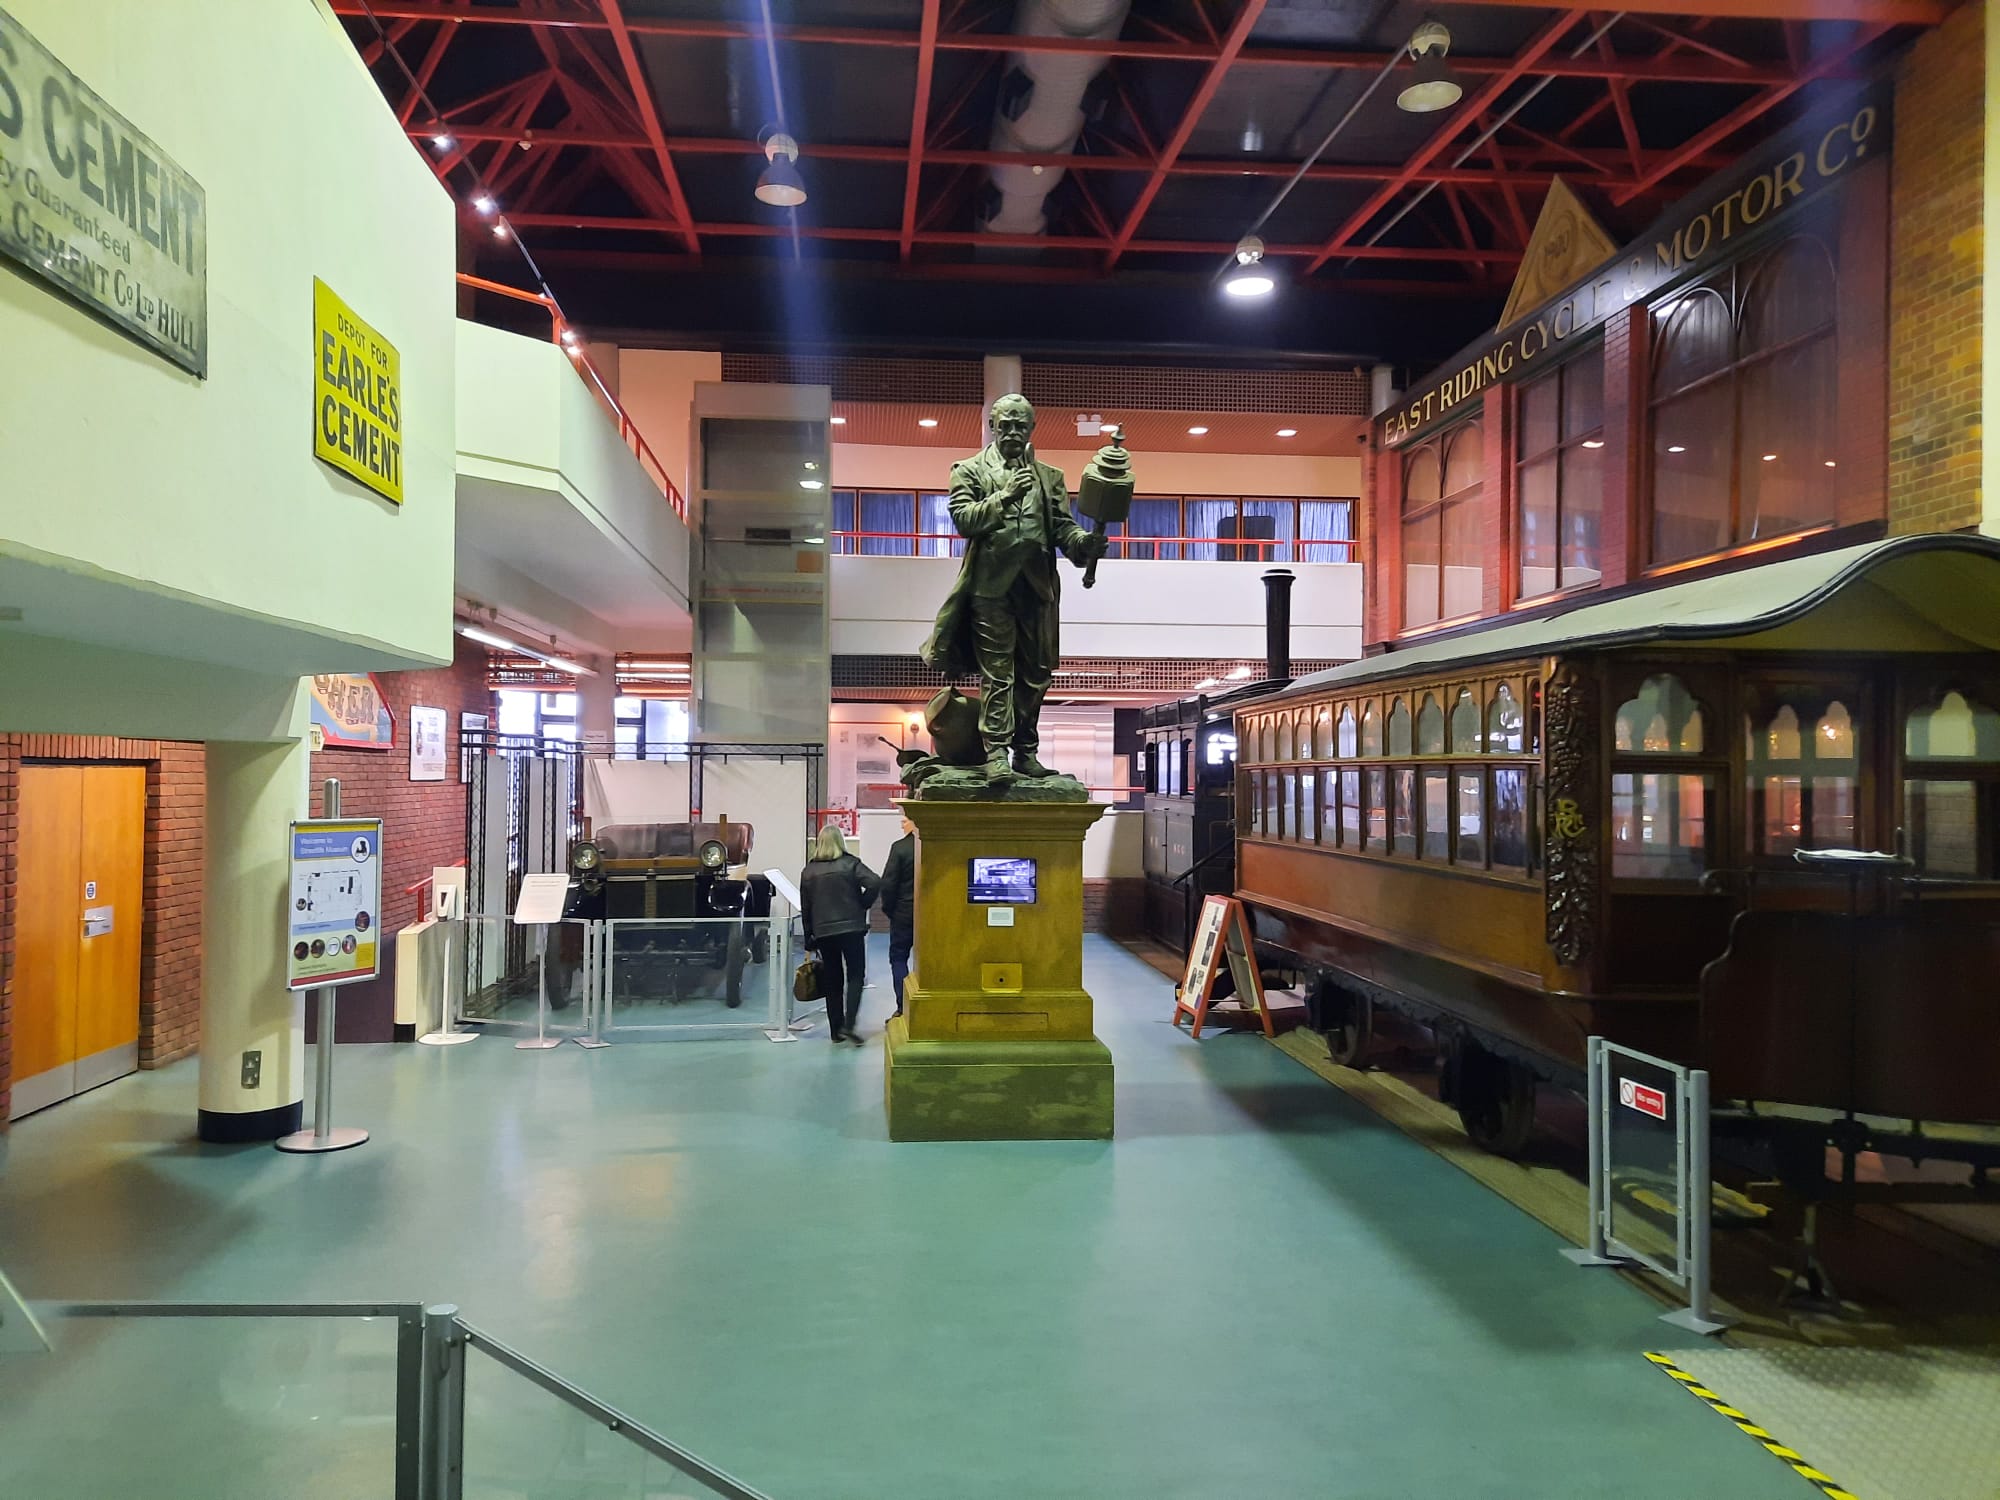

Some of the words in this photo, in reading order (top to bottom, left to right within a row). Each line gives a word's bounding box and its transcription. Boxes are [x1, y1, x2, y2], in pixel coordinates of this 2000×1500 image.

[25, 167, 131, 265] Guaranteed
[41, 75, 200, 276] CEMENT
[157, 298, 197, 353] HULL
[337, 313, 366, 352] DEPOT
[371, 341, 388, 370] FOR
[1384, 391, 1435, 445] EAST
[1440, 341, 1513, 412] RIDING
[1521, 279, 1611, 360] CYCLE
[1655, 151, 1805, 276] MOTOR
[322, 328, 399, 433] EARLE'S
[322, 394, 400, 488] CEMENT
